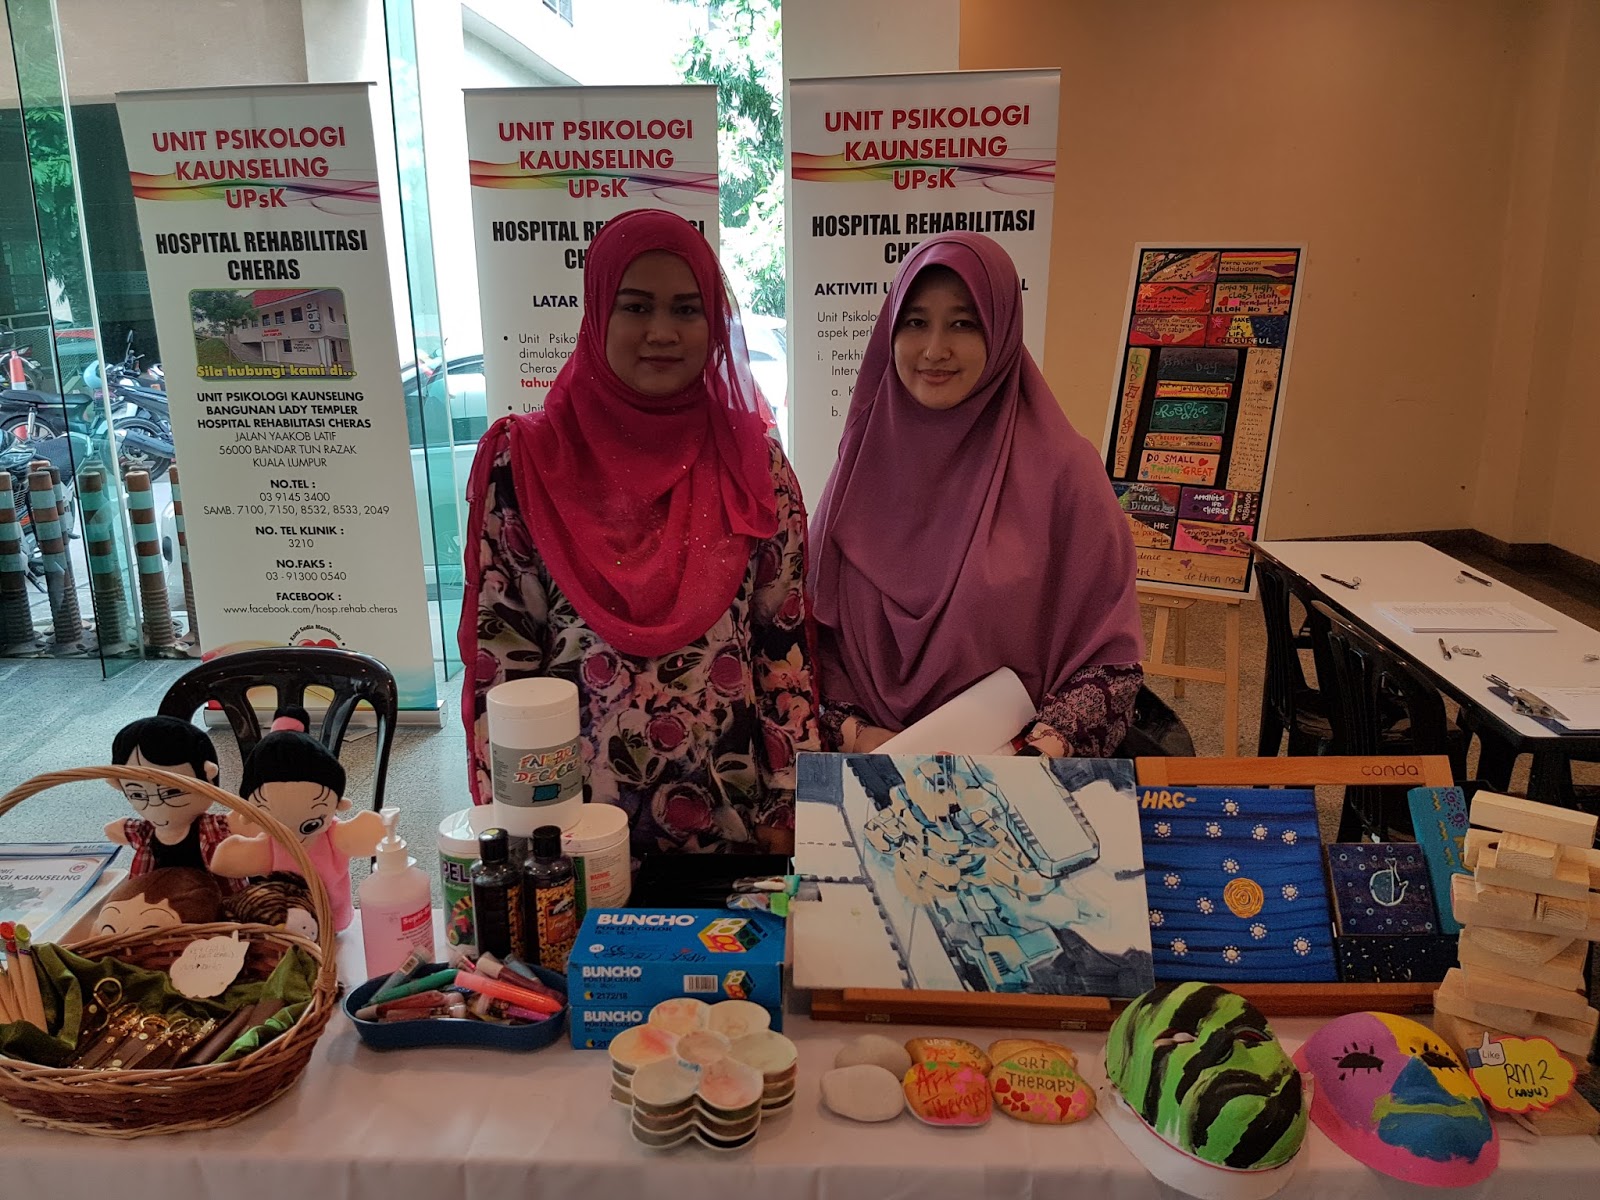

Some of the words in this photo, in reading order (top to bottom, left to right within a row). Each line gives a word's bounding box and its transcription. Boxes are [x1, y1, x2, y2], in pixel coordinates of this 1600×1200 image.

[825, 110, 883, 132] UNIT
[892, 105, 1030, 130] PSIKOLOGI
[498, 122, 555, 142] UNIT
[563, 120, 693, 141] PSIKOLOGI
[152, 131, 206, 152] UNIT
[216, 127, 345, 150] PSIKOLOGI
[845, 136, 1008, 161] KAUNSELING
[519, 149, 674, 170] KAUNSELING
[175, 157, 329, 180] KAUNSELING
[893, 168, 956, 190] UPsK
[568, 178, 629, 199] UPsK
[225, 188, 288, 209] UPsK
[812, 214, 901, 237] HOSPITAL
[906, 210, 1036, 234] REHABILITASI
[492, 221, 579, 242] HOSPITAL
[156, 233, 241, 254] HOSPITAL
[245, 230, 367, 252] REHABILITASI
[227, 259, 300, 281] CHERAS
[814, 282, 877, 296] AKTIVITI
[533, 295, 579, 308] LATAR
[817, 312, 838, 323] Unit
[842, 310, 879, 322] Psikolo
[518, 333, 540, 344] Unit
[549, 333, 580, 344] Psikol
[817, 326, 849, 340] aspek
[1216, 337, 1272, 345] COLOURFUL
[832, 349, 863, 361] Perkhi
[197, 365, 222, 377] Sila
[227, 365, 285, 379] hubungi
[290, 365, 326, 377] kami
[329, 364, 357, 377] di...
[520, 363, 557, 374] Cheras
[197, 392, 223, 402] UNIT
[227, 392, 288, 401] PSIKOLOGI
[291, 391, 364, 401] KAUNSELING
[206, 405, 275, 415] BANGUNAN
[279, 405, 308, 415] LADY
[311, 405, 358, 415] TEMPLER
[198, 419, 251, 429] HOSPITAL
[253, 418, 325, 428] REHABILITASI
[329, 418, 371, 428] CHERAS
[235, 432, 267, 442] JALAN
[269, 432, 311, 441] YAAKOB
[314, 431, 337, 441] LATIF
[219, 445, 252, 455] 56000
[255, 445, 297, 454] BANDAR
[299, 445, 321, 454] TUN
[324, 445, 357, 454] RAZAK
[252, 458, 285, 468] KUALA
[288, 458, 327, 467] LUMPUR
[1146, 453, 1160, 463] DO
[1163, 453, 1195, 464] SMALL
[1183, 465, 1215, 477] GREAT
[270, 479, 309, 489] NO.TEL
[259, 492, 273, 502] 03
[276, 492, 301, 502] 9145
[304, 492, 331, 502] 3400
[203, 506, 235, 515] SAMB.
[237, 505, 267, 516] 7100,
[270, 505, 298, 516] 7150,
[301, 505, 330, 516] 8532,
[333, 505, 361, 516] 8533,
[363, 505, 390, 515] 2049
[255, 526, 278, 536] NO.
[280, 526, 297, 535] TEL
[300, 526, 337, 535] KLINIK
[288, 539, 314, 548] 3210
[276, 559, 325, 569] NO.FAKS
[266, 572, 278, 581] 03
[286, 572, 318, 581] 91300
[320, 572, 347, 581] 0540
[276, 592, 335, 601] FACEBOOK
[223, 604, 398, 616] www.facebook.com/hosp.rehab.cheras
[289, 628, 301, 641] Kami
[299, 624, 315, 632] Sedia
[1361, 763, 1419, 778] conda
[597, 914, 695, 926] BUNCHO
[583, 966, 642, 978] BUNCHO
[583, 1011, 643, 1022] BUNCHO
[1482, 1049, 1501, 1060] Like
[1504, 1063, 1536, 1085] RM
